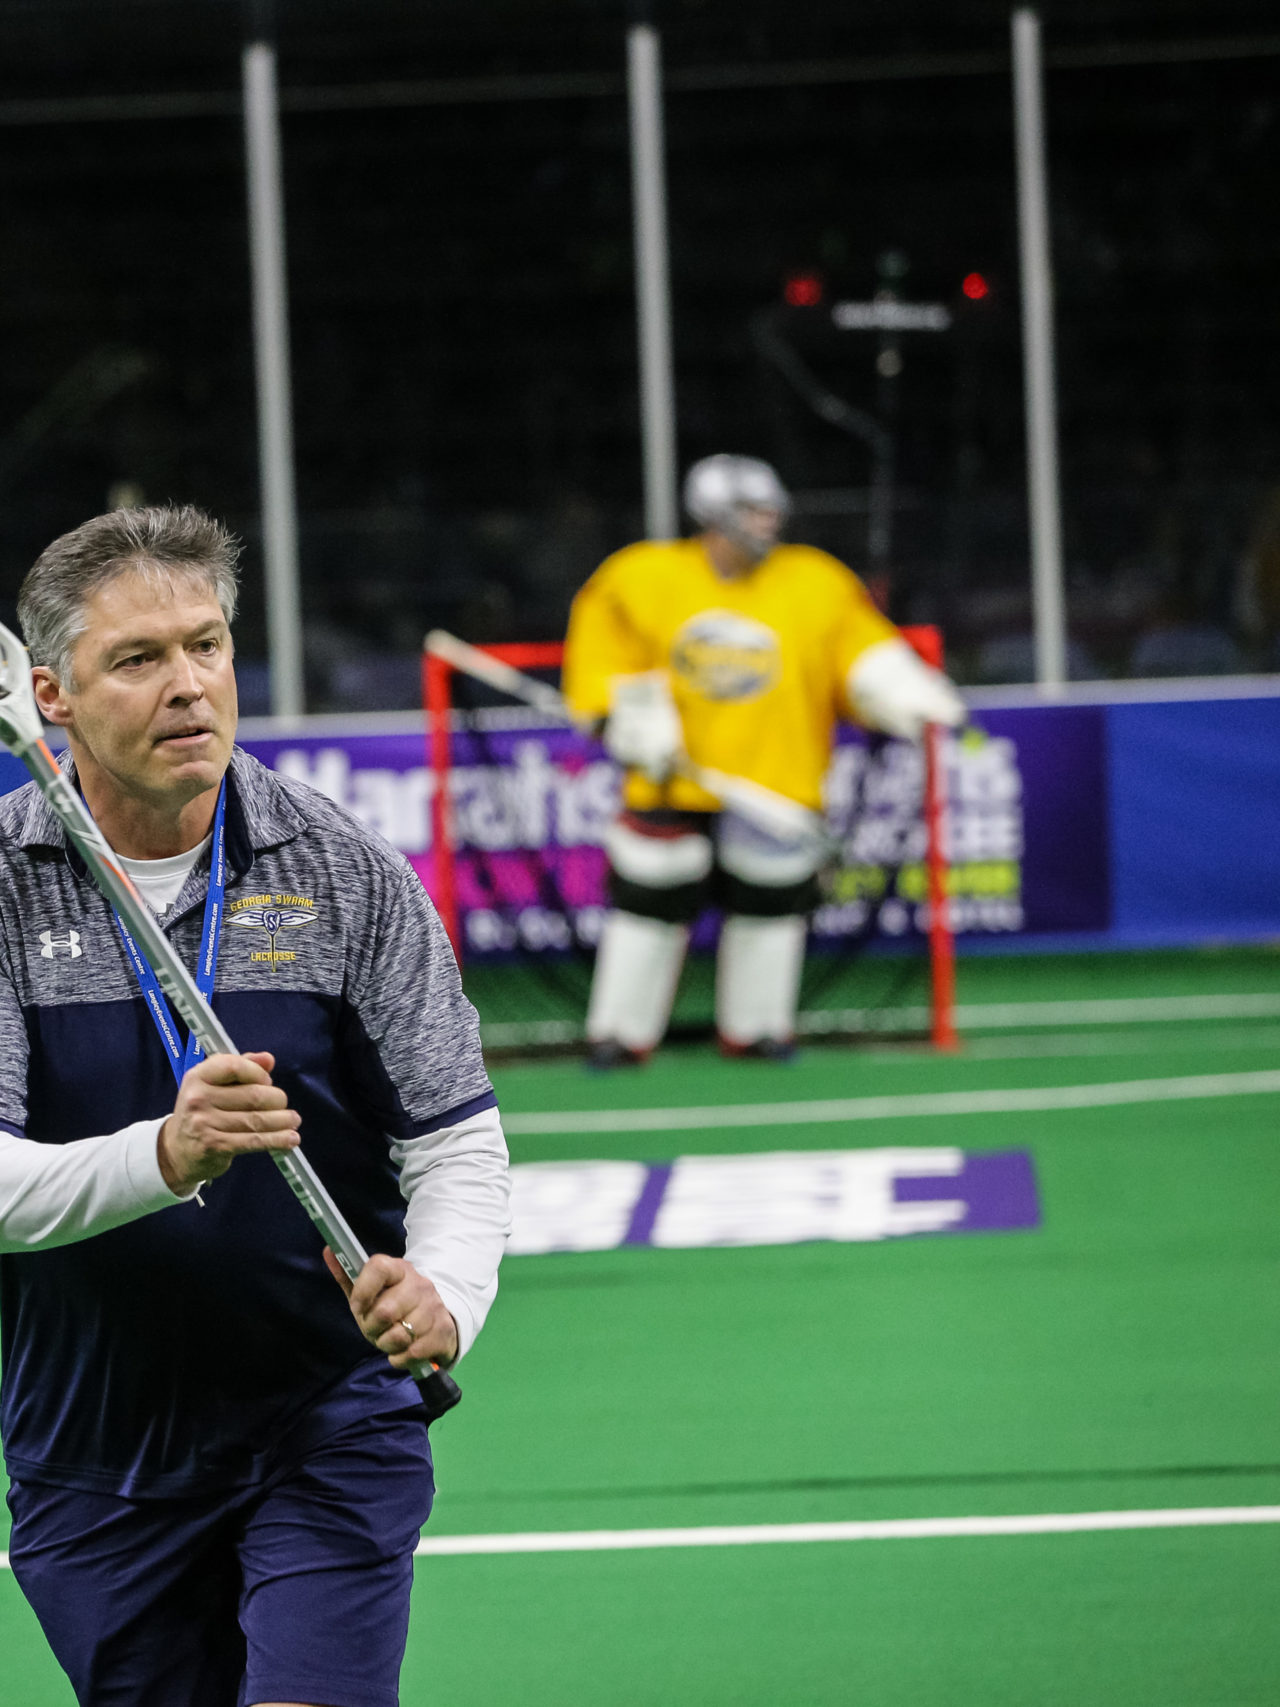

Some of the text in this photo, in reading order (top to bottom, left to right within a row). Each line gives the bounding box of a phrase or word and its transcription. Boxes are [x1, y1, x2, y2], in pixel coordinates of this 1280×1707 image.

[230, 894, 314, 912] GEORGIA SWARM
[250, 951, 297, 961] LACROSSE
[154, 967, 219, 1060] UNDE
[272, 1154, 323, 1221] OUR
